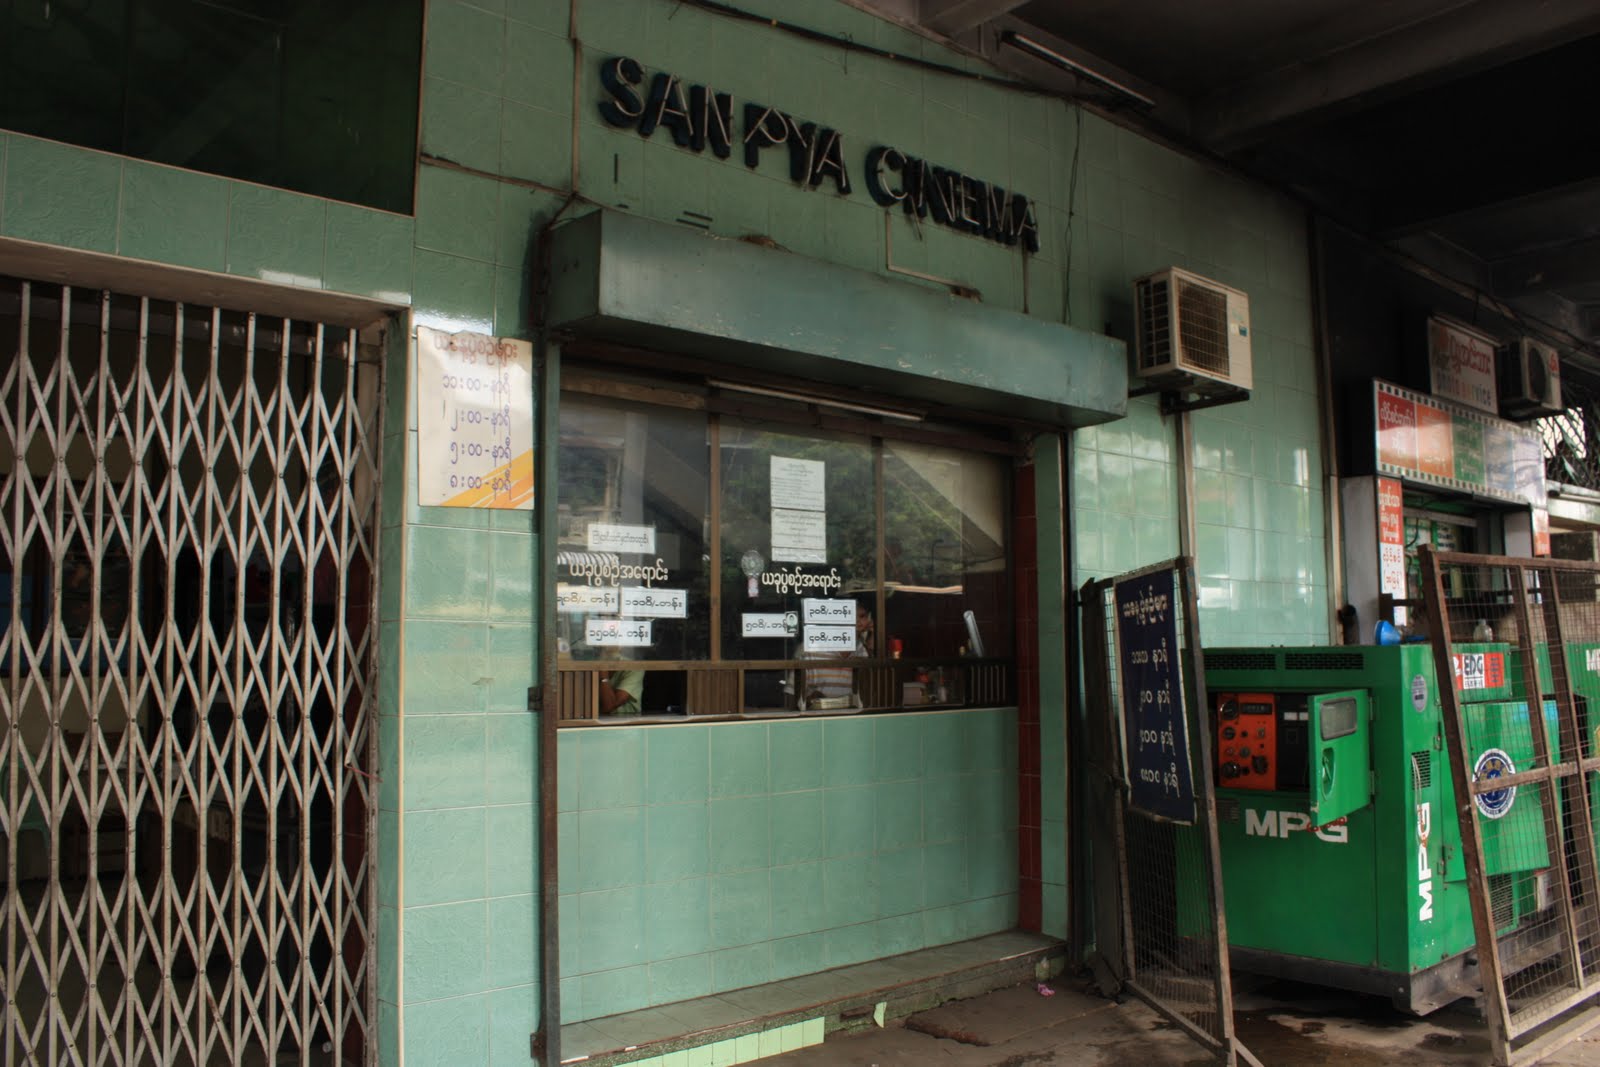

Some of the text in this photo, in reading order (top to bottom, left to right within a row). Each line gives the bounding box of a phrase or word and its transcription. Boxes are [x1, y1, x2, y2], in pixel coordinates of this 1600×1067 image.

[599, 56, 1040, 253] SAN PYA CINEMA
[1245, 809, 1348, 843] MPG
[1417, 802, 1433, 921] MPG
